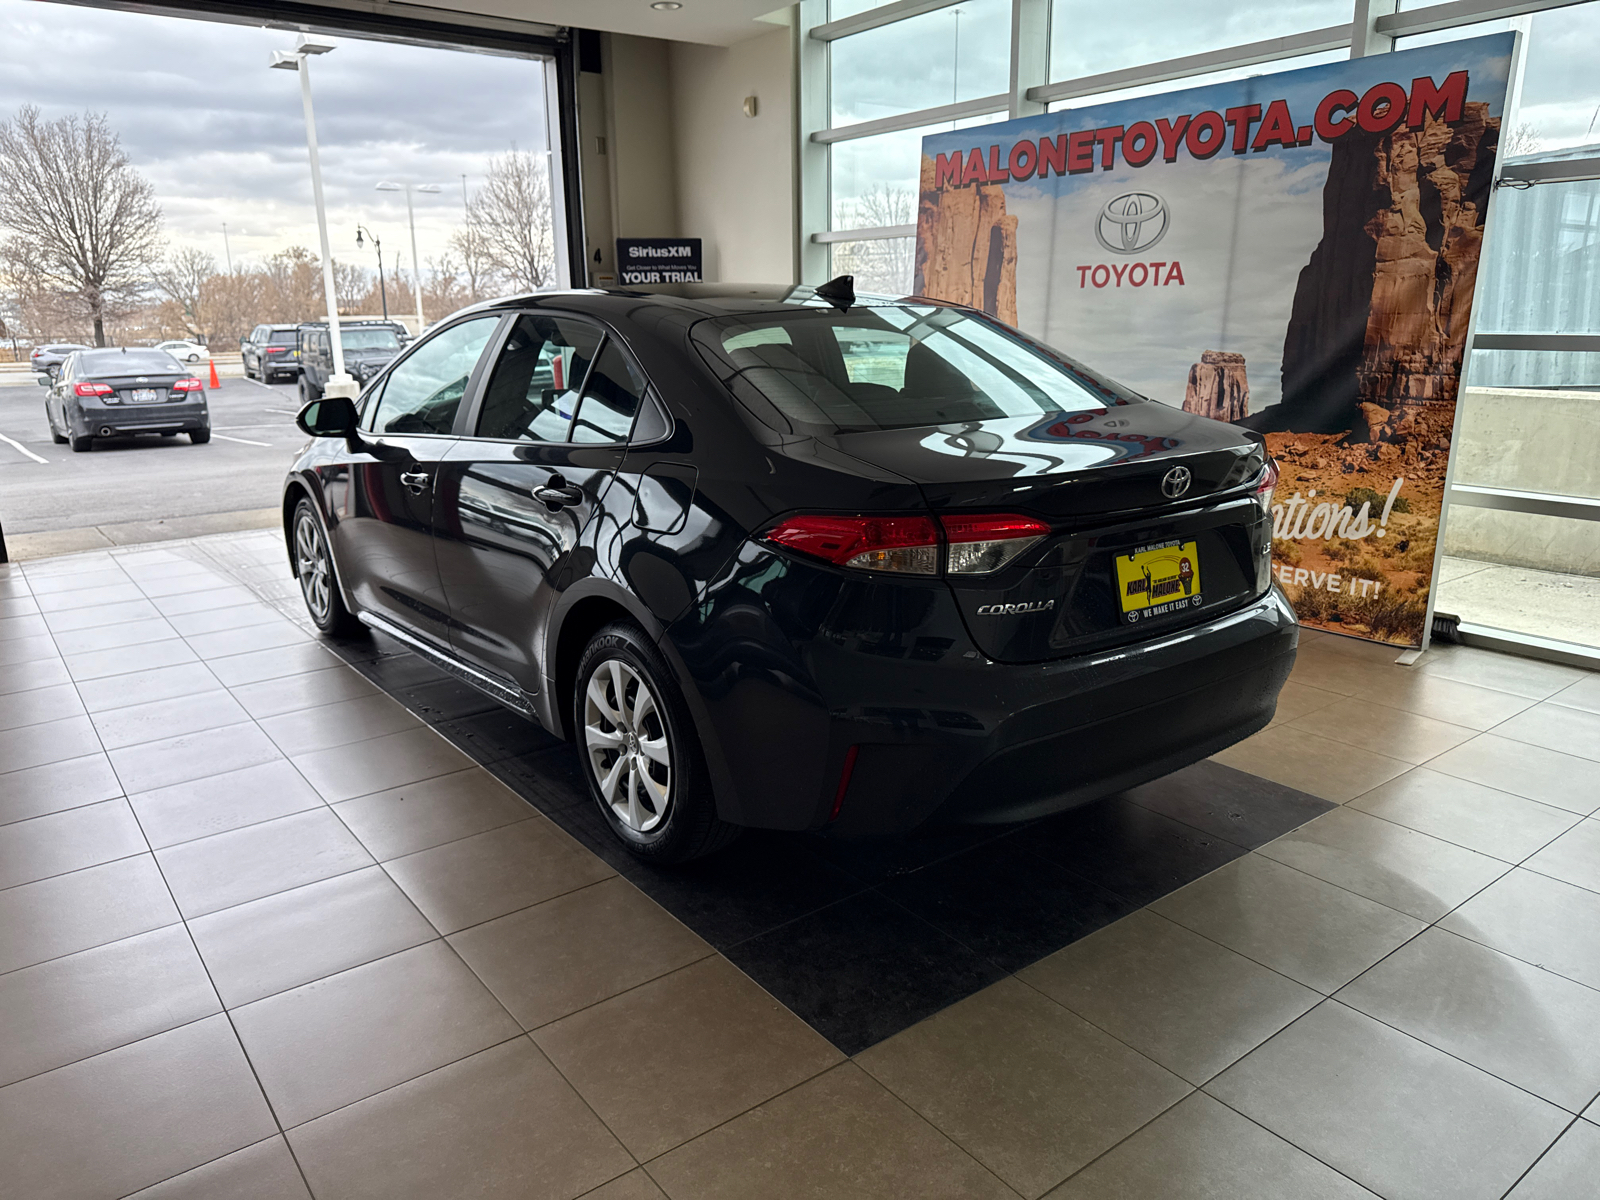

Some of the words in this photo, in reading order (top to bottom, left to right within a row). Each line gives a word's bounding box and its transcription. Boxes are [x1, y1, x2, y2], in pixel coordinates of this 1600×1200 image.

[934, 69, 1470, 191] MALONETOYOTA.COM
[593, 248, 602, 264] 4
[628, 246, 692, 258] SiriusXM
[622, 272, 660, 284] YOUR
[662, 272, 702, 283] TRIAL
[1076, 260, 1185, 289] TOYOTA
[1147, 543, 1164, 552] MALONE
[1165, 540, 1180, 548] TOYOTA
[1181, 562, 1189, 572] 32
[1126, 578, 1148, 596] KARL
[1151, 579, 1181, 599] MALONE
[1272, 563, 1342, 593] ERVE
[1350, 577, 1381, 600] IT!
[976, 599, 1055, 616] COROLLA
[1143, 609, 1152, 618] WE
[1152, 604, 1169, 616] MAKE
[1169, 602, 1175, 611] IT
[1175, 599, 1189, 610] EASY
